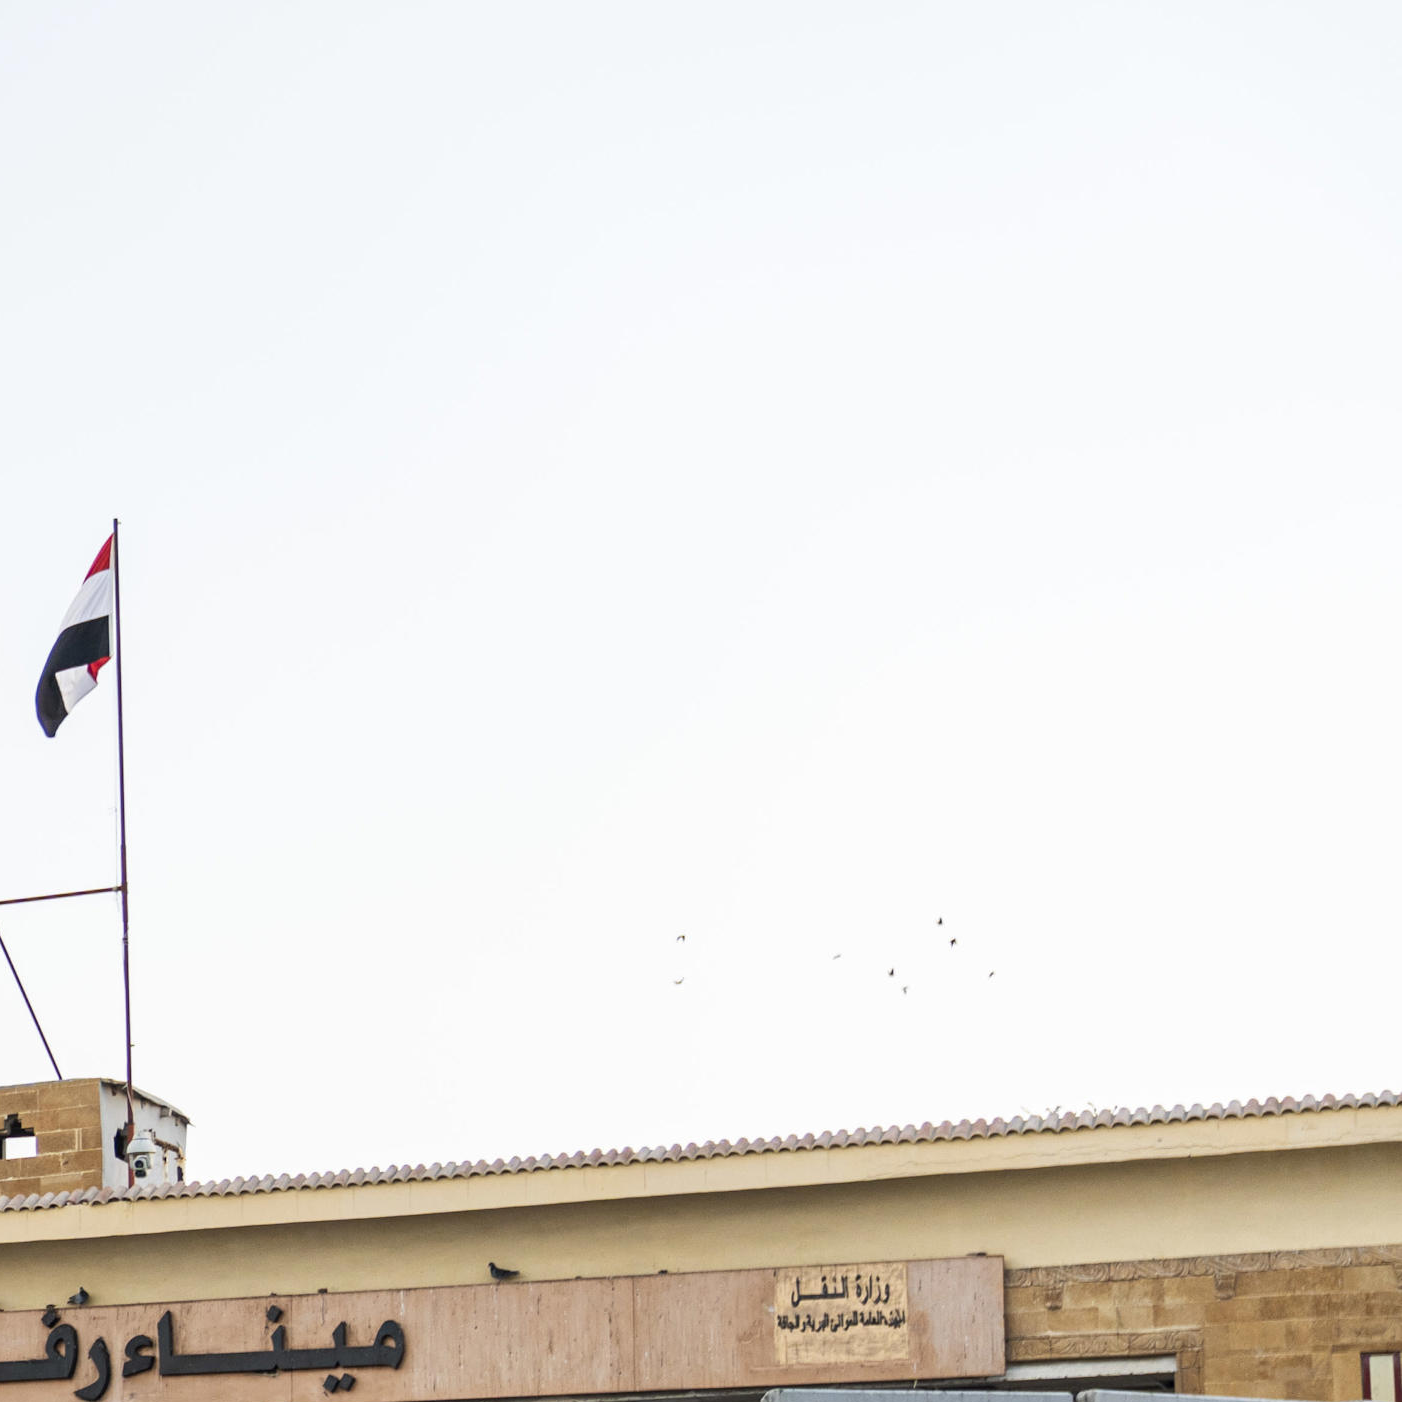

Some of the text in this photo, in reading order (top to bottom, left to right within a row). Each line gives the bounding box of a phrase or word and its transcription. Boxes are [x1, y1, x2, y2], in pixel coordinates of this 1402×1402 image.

[790, 1273, 891, 1308] وزارة النقل
[121, 1304, 406, 1395] ميناء
